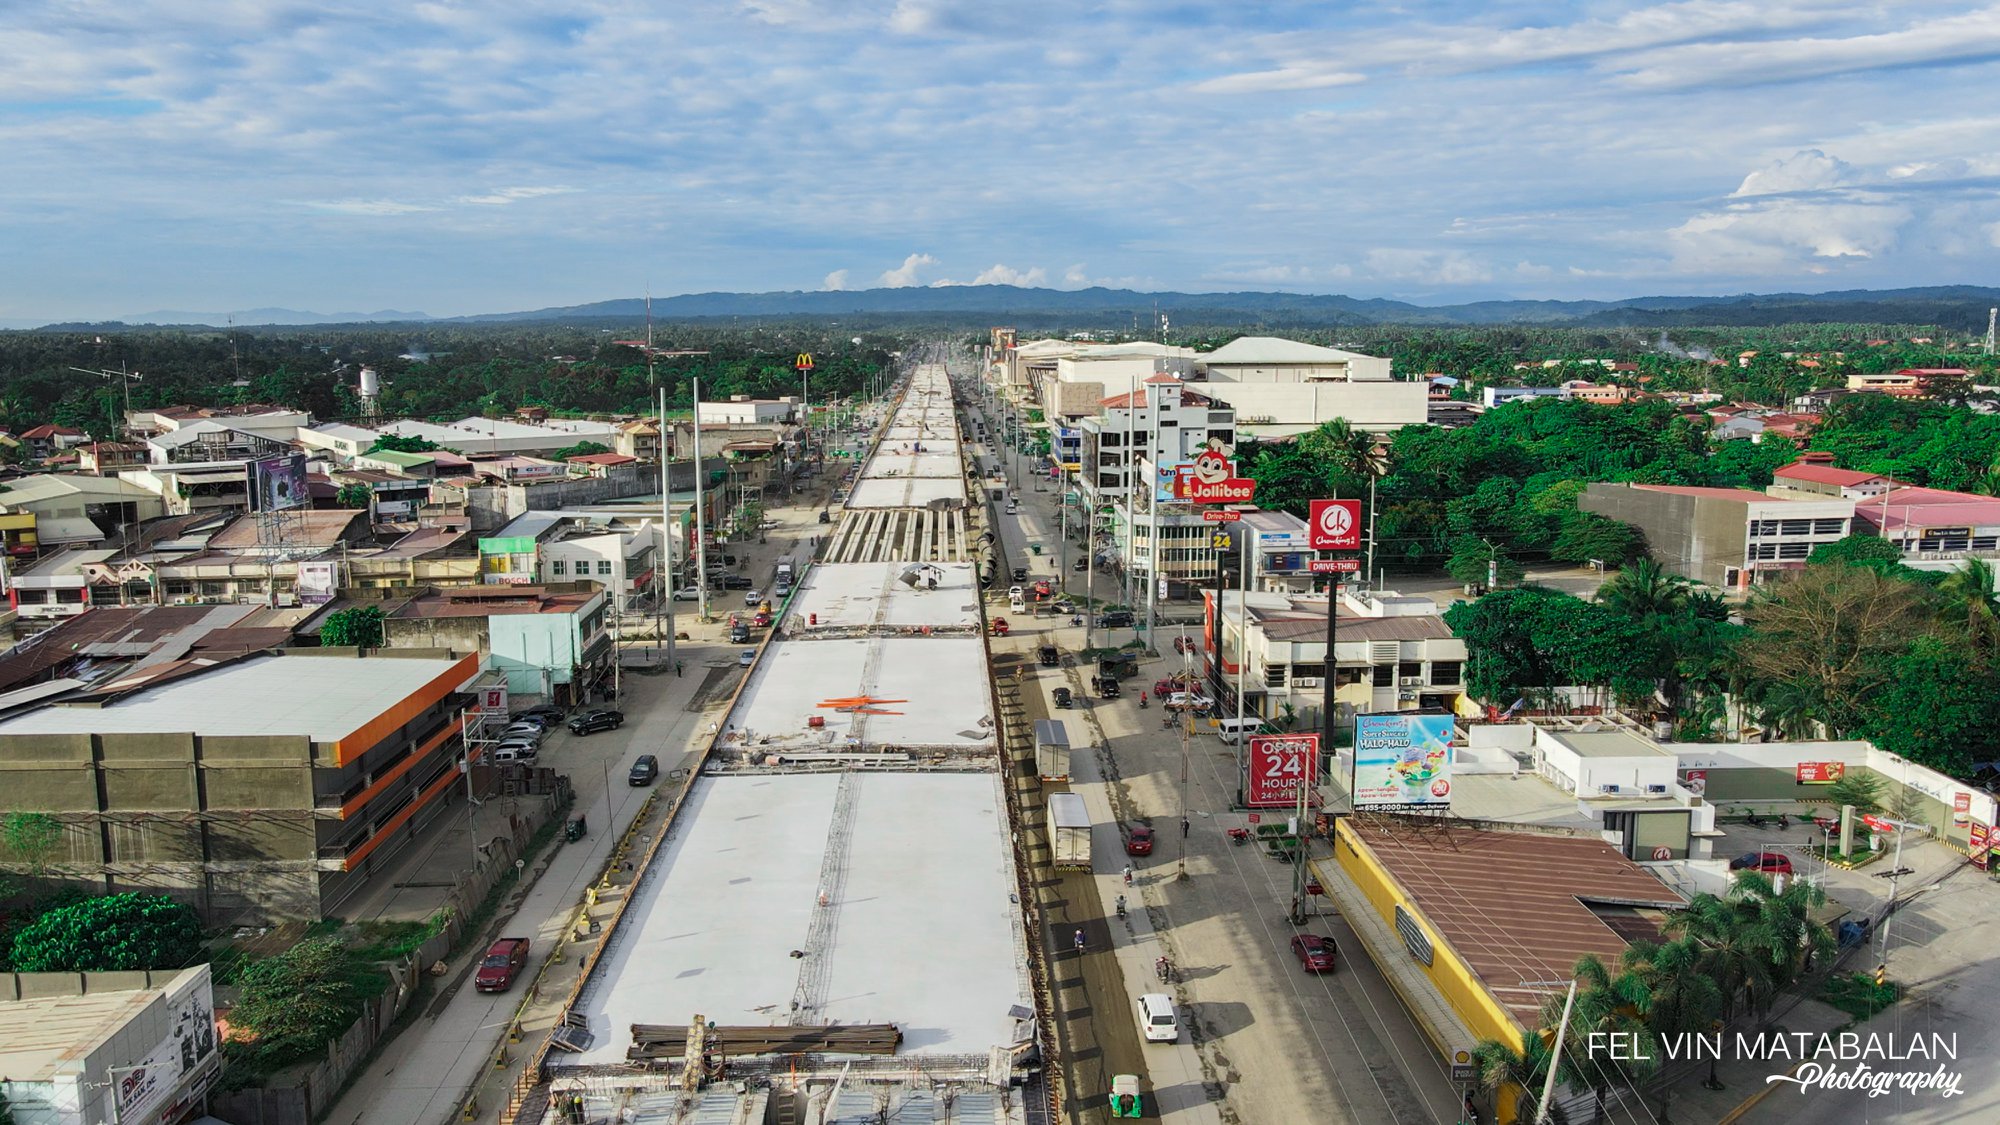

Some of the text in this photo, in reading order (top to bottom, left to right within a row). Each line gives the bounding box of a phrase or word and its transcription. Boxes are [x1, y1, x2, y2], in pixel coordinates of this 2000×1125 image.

[1193, 485, 1250, 497] Jollibee
[1213, 536, 1231, 547] 24
[1312, 562, 1357, 571] DRIVE-THRU
[499, 577, 528, 585] BOSCH
[1261, 742, 1311, 755] OPEN
[1360, 739, 1410, 749] HALO-HALO
[1266, 755, 1302, 778] 24
